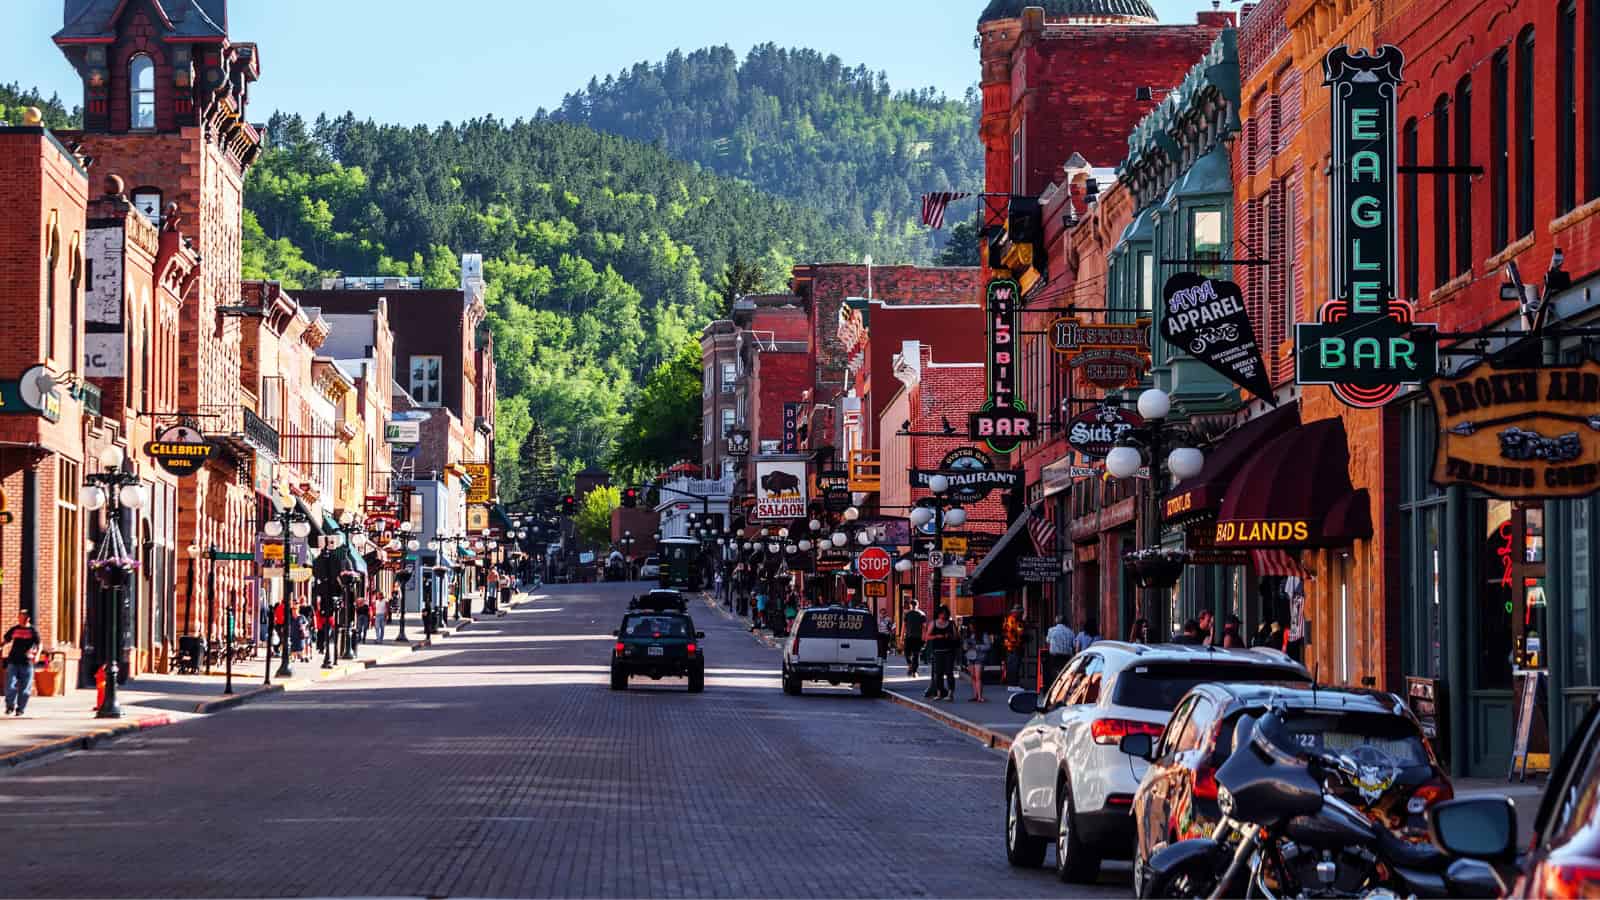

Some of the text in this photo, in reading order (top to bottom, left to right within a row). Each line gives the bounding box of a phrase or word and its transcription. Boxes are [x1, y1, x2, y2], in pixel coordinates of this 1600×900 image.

[1350, 108, 1382, 314] EAGLE
[1167, 295, 1244, 336] APPAREL
[995, 288, 1011, 408] WILD BILL
[1319, 336, 1417, 370] BAR
[1440, 372, 1538, 417] BROKEN
[978, 418, 1031, 437] BAR
[1069, 422, 1113, 444] Sick
[150, 444, 211, 456] CELEBRITY
[167, 459, 192, 467] HOTEL
[917, 472, 1018, 485] RTAURANT
[759, 503, 805, 517] SALOON
[1215, 522, 1236, 543] BAD
[1239, 520, 1309, 542] LANDS
[860, 557, 889, 571] STOP
[811, 613, 845, 621] DAKOTA
